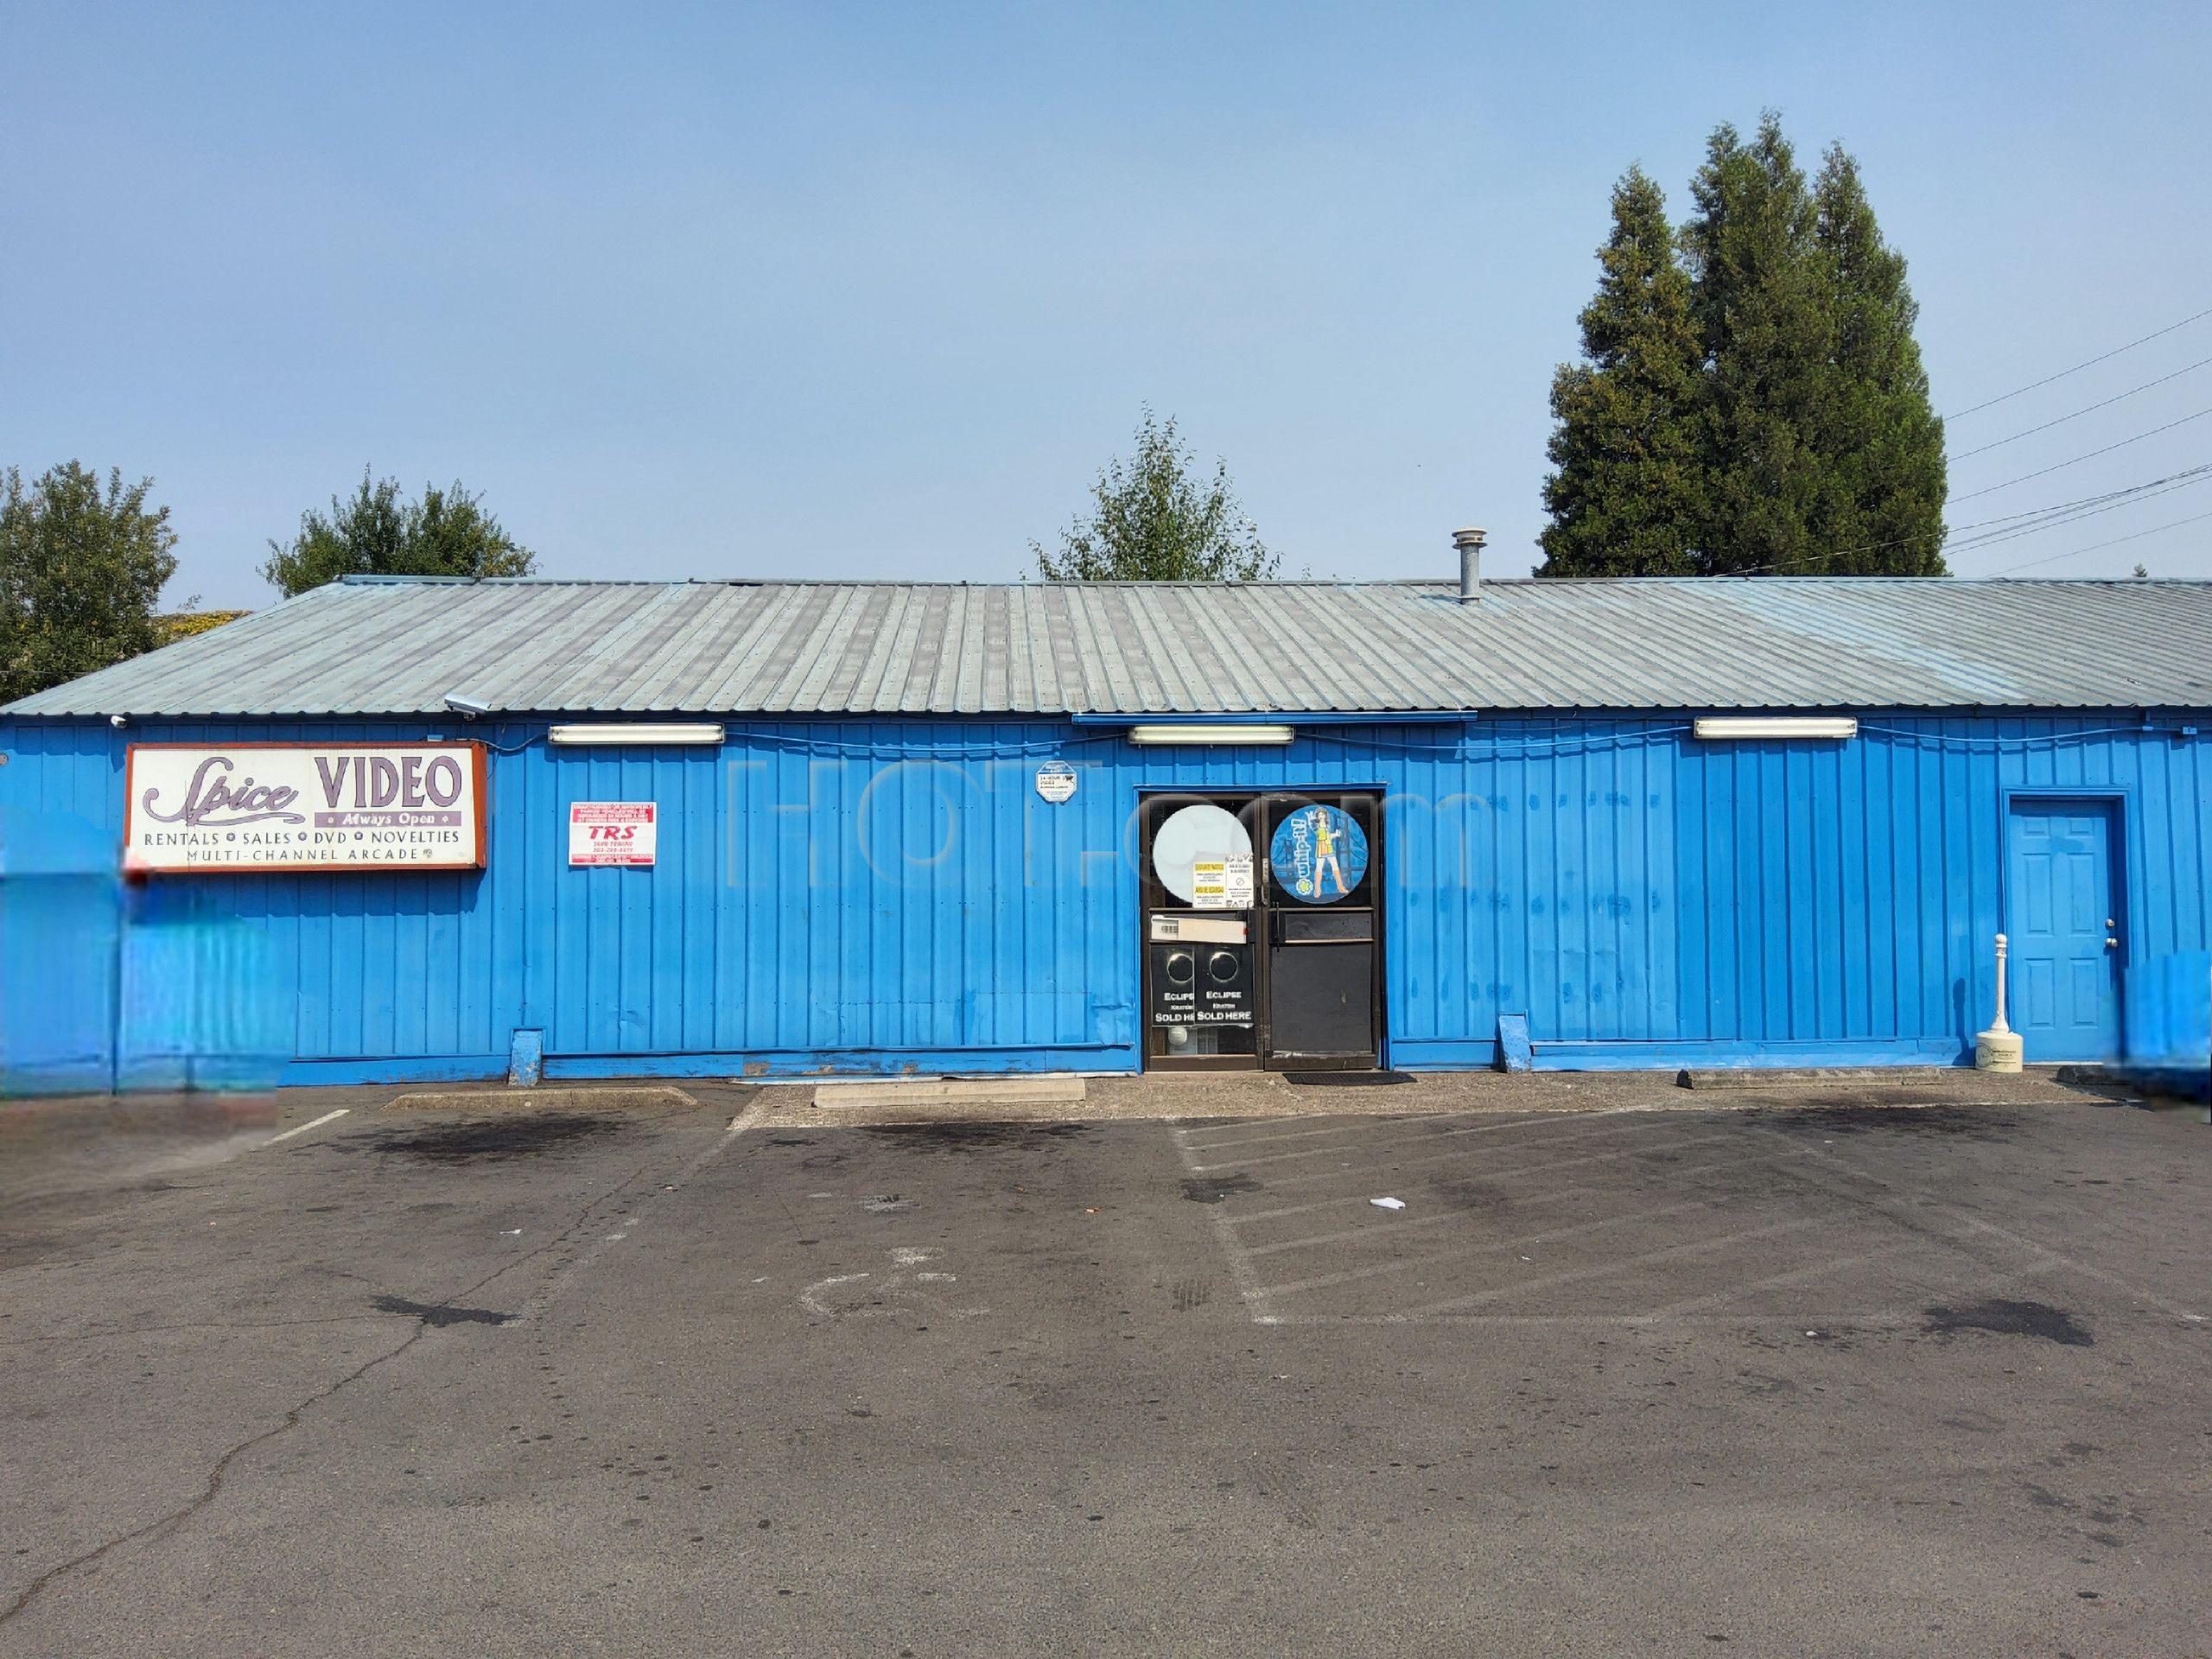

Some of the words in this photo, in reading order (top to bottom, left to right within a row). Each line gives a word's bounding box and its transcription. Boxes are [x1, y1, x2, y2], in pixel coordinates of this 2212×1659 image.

[143, 756, 305, 827] Spice
[315, 755, 462, 809] VIDEO
[342, 813, 392, 827] Always
[398, 812, 435, 826] Open
[144, 832, 219, 846] RENTALS
[243, 832, 291, 844] SALES
[315, 832, 346, 844] DVD
[372, 830, 460, 843] NOVELTIES
[588, 825, 638, 840] TRS
[187, 849, 338, 861] MULTI-CHANNEL
[348, 849, 417, 860] ARCADE
[1291, 818, 1311, 878] whip-it!
[1155, 1013, 1182, 1022] SOLD
[1197, 1011, 1224, 1020] SOLD
[1225, 1011, 1252, 1020] HERE
